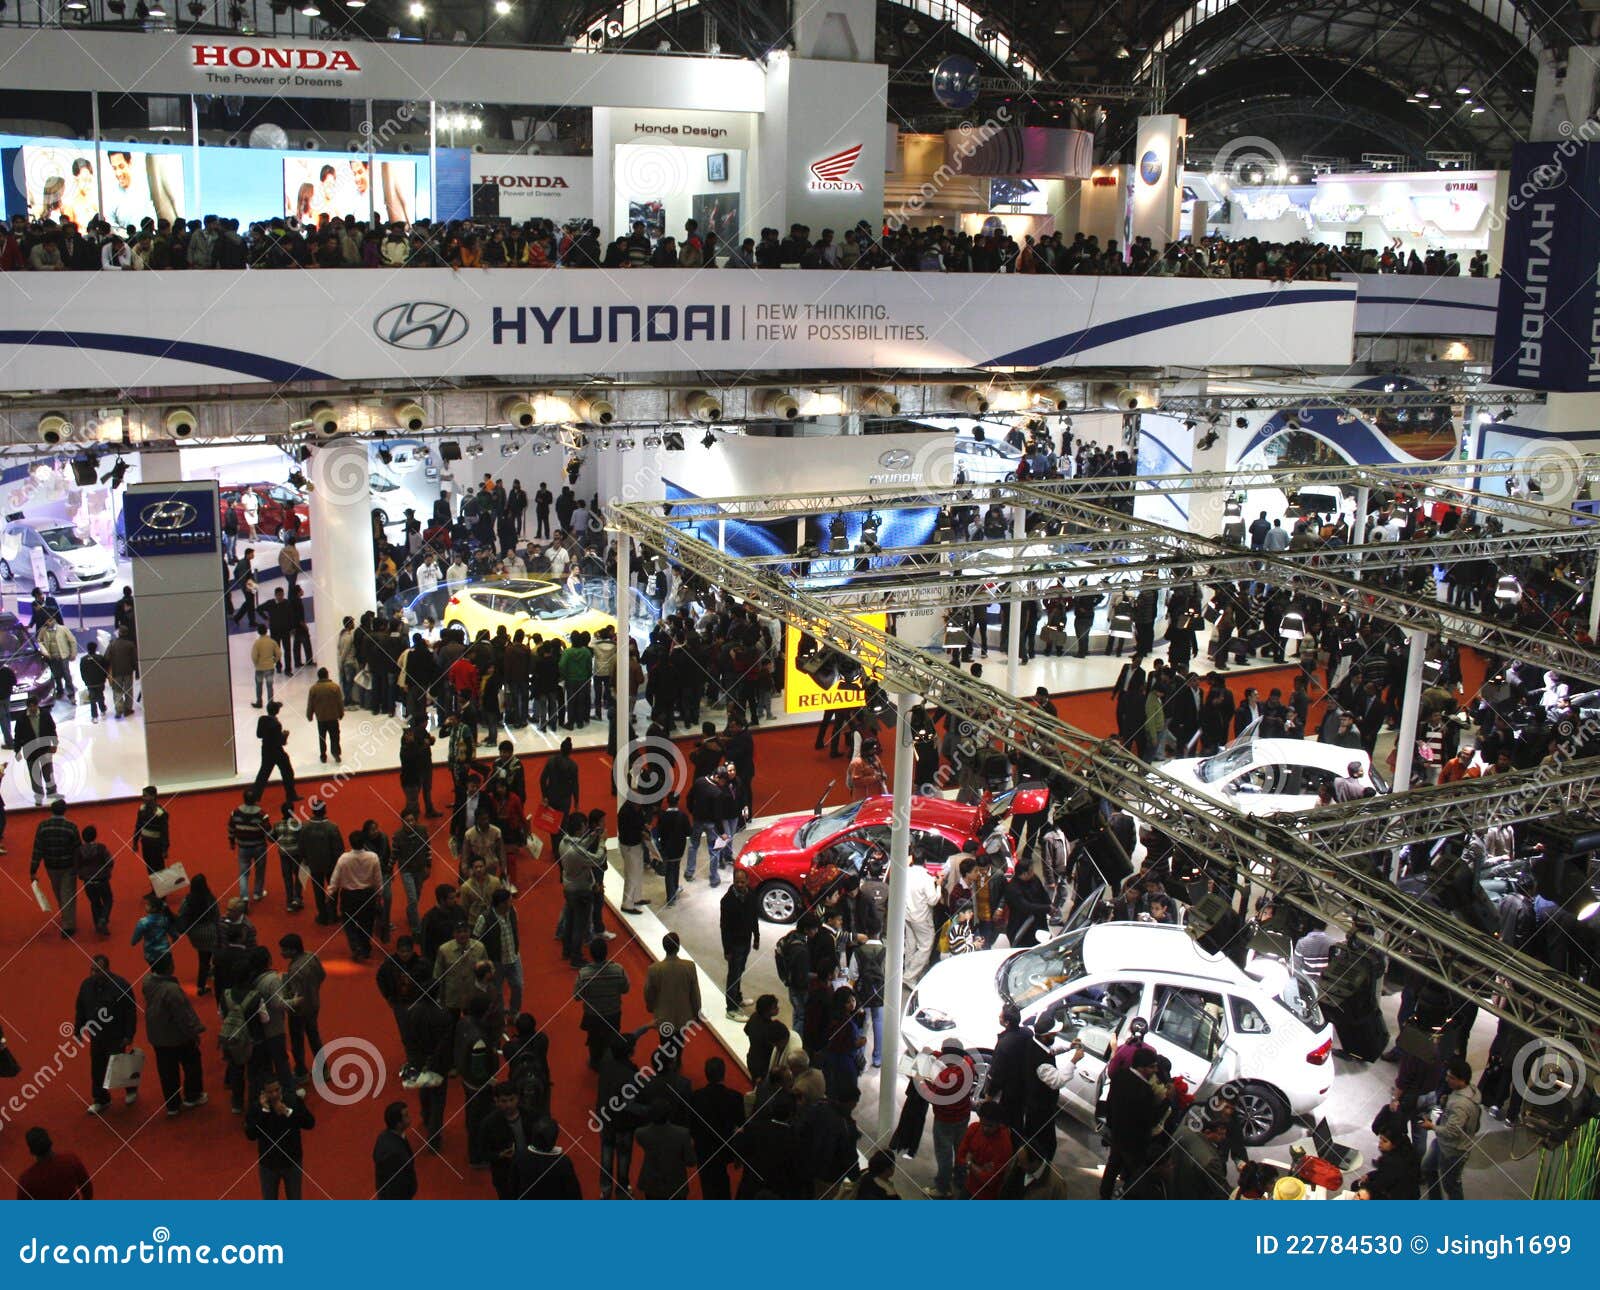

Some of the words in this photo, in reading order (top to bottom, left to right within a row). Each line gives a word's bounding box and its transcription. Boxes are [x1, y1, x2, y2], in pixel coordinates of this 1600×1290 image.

[192, 45, 361, 71] HONDA
[206, 72, 230, 84] The
[235, 73, 275, 85] Power
[279, 75, 291, 85] of
[295, 75, 343, 87] Dreams
[634, 123, 678, 135] Honda
[683, 125, 728, 138] Design
[480, 175, 569, 189] HONDA
[811, 181, 864, 193] HONDA
[1517, 203, 1555, 378] HYUNDAI
[756, 303, 797, 320] NEW
[804, 304, 891, 321] THINKING.
[492, 305, 730, 345] HYUNDAI
[756, 325, 797, 341] NEW
[808, 325, 929, 342] POSSIBILITIES.
[798, 690, 866, 707] RENAUL
